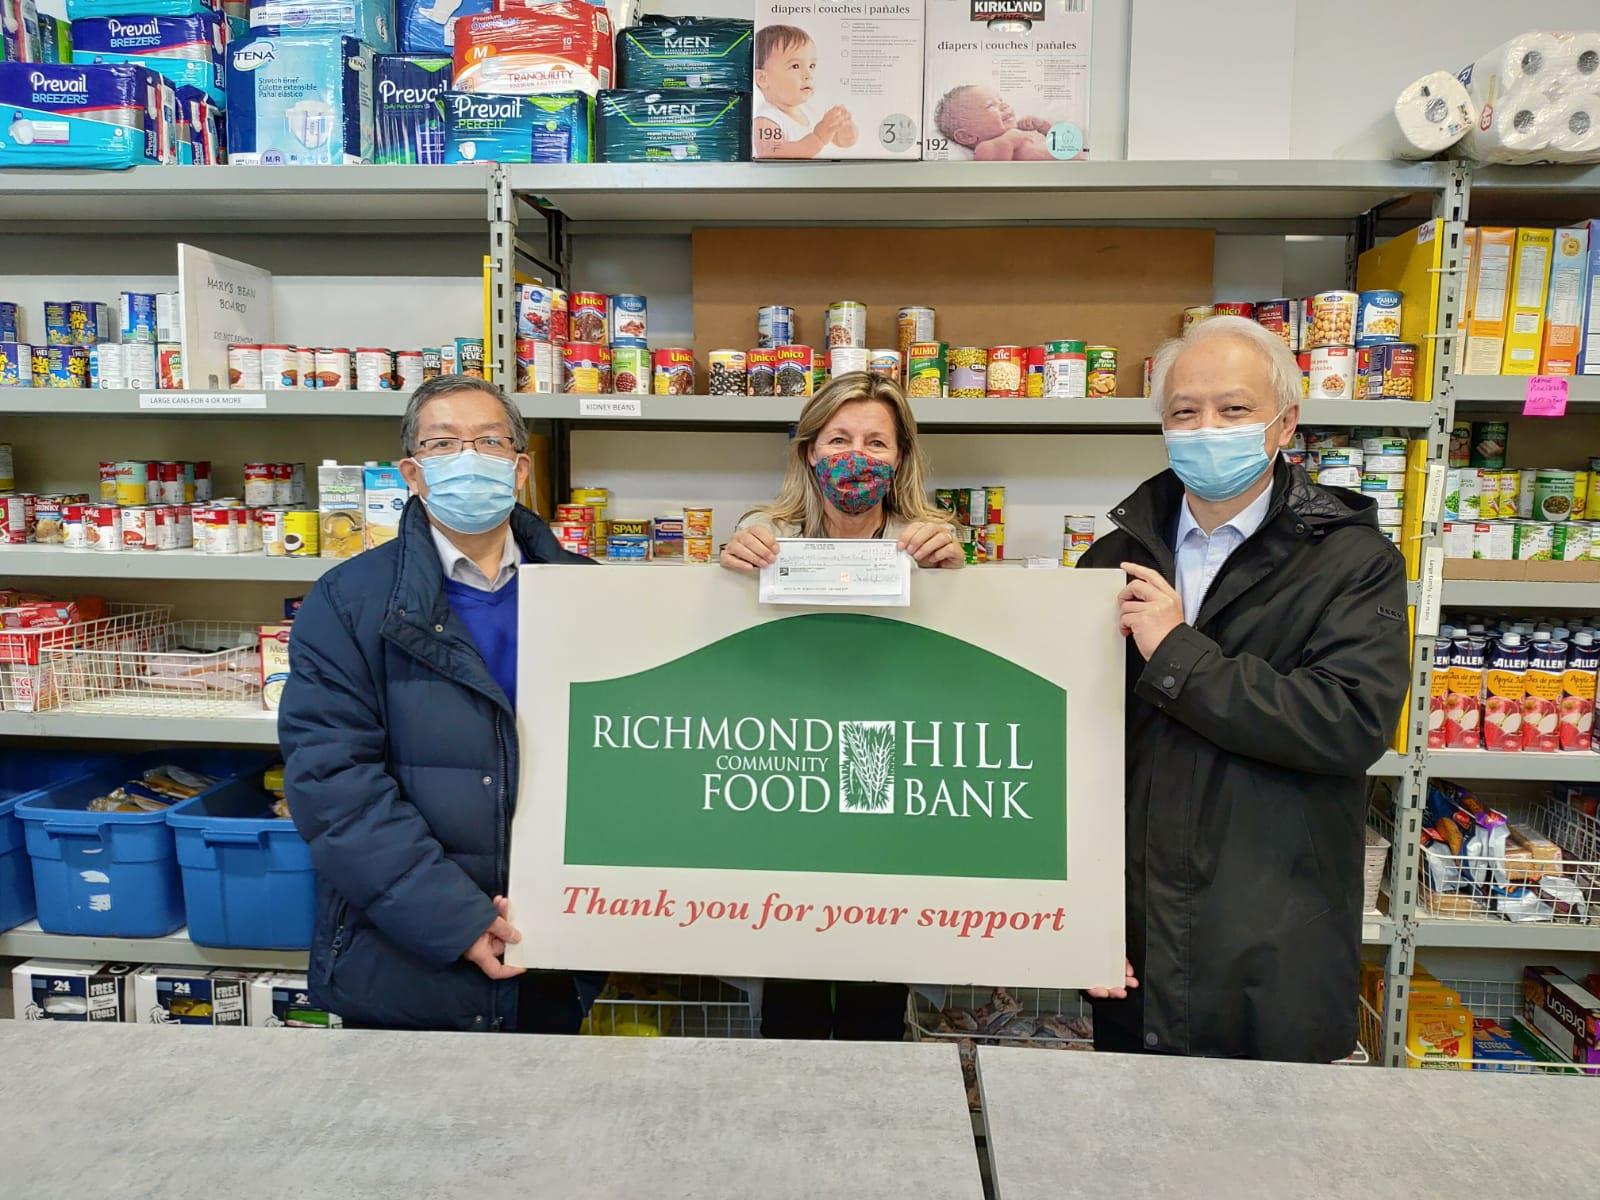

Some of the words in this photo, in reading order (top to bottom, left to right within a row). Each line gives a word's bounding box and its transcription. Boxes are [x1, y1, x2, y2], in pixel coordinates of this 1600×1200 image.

[771, 4, 810, 15] diapers
[818, 5, 861, 14] couches
[869, 4, 910, 15] pañales
[974, 2, 1042, 12] KIRKLAND
[108, 18, 160, 38] Prevail
[110, 35, 161, 48] BREEZERS
[665, 36, 709, 48] MEN
[937, 41, 977, 52] diapers
[985, 41, 1029, 51] couches
[1036, 40, 1077, 52] pañales
[234, 51, 275, 61] TENA
[474, 46, 488, 59] M
[507, 70, 576, 81] TRANQUILITY
[30, 72, 87, 92] Prevail
[32, 94, 88, 105] BREEZERS
[454, 97, 522, 119] Prevail
[648, 104, 695, 115] MEN
[758, 128, 782, 140] 198
[883, 124, 896, 144] 3
[926, 139, 949, 151] 192
[1050, 131, 1056, 151] 1
[237, 285, 257, 299] BEAN
[219, 299, 247, 314] BOARD
[576, 296, 603, 306] Unico
[750, 352, 776, 363] Unico
[778, 350, 804, 360] Unico
[613, 524, 642, 534] SPAM
[1494, 675, 1513, 685] Apple
[1570, 675, 1588, 685] Apple
[592, 714, 834, 753] RICHMOND
[903, 720, 1034, 771] HILL
[716, 755, 829, 773] COMMUNITY
[702, 773, 832, 814] FOOD
[904, 778, 1034, 820] BANK
[563, 886, 676, 918] Thank
[680, 896, 750, 927] you
[752, 892, 814, 930] for
[815, 903, 908, 933] your
[917, 906, 1067, 938] support
[53, 979, 71, 992] 24
[90, 982, 115, 996] FREE
[174, 982, 191, 994] 24
[216, 985, 239, 999] FREE
[91, 1008, 115, 1020] TOOLS
[216, 1010, 241, 1022] TOOLS
[1547, 994, 1586, 1038] Breton
